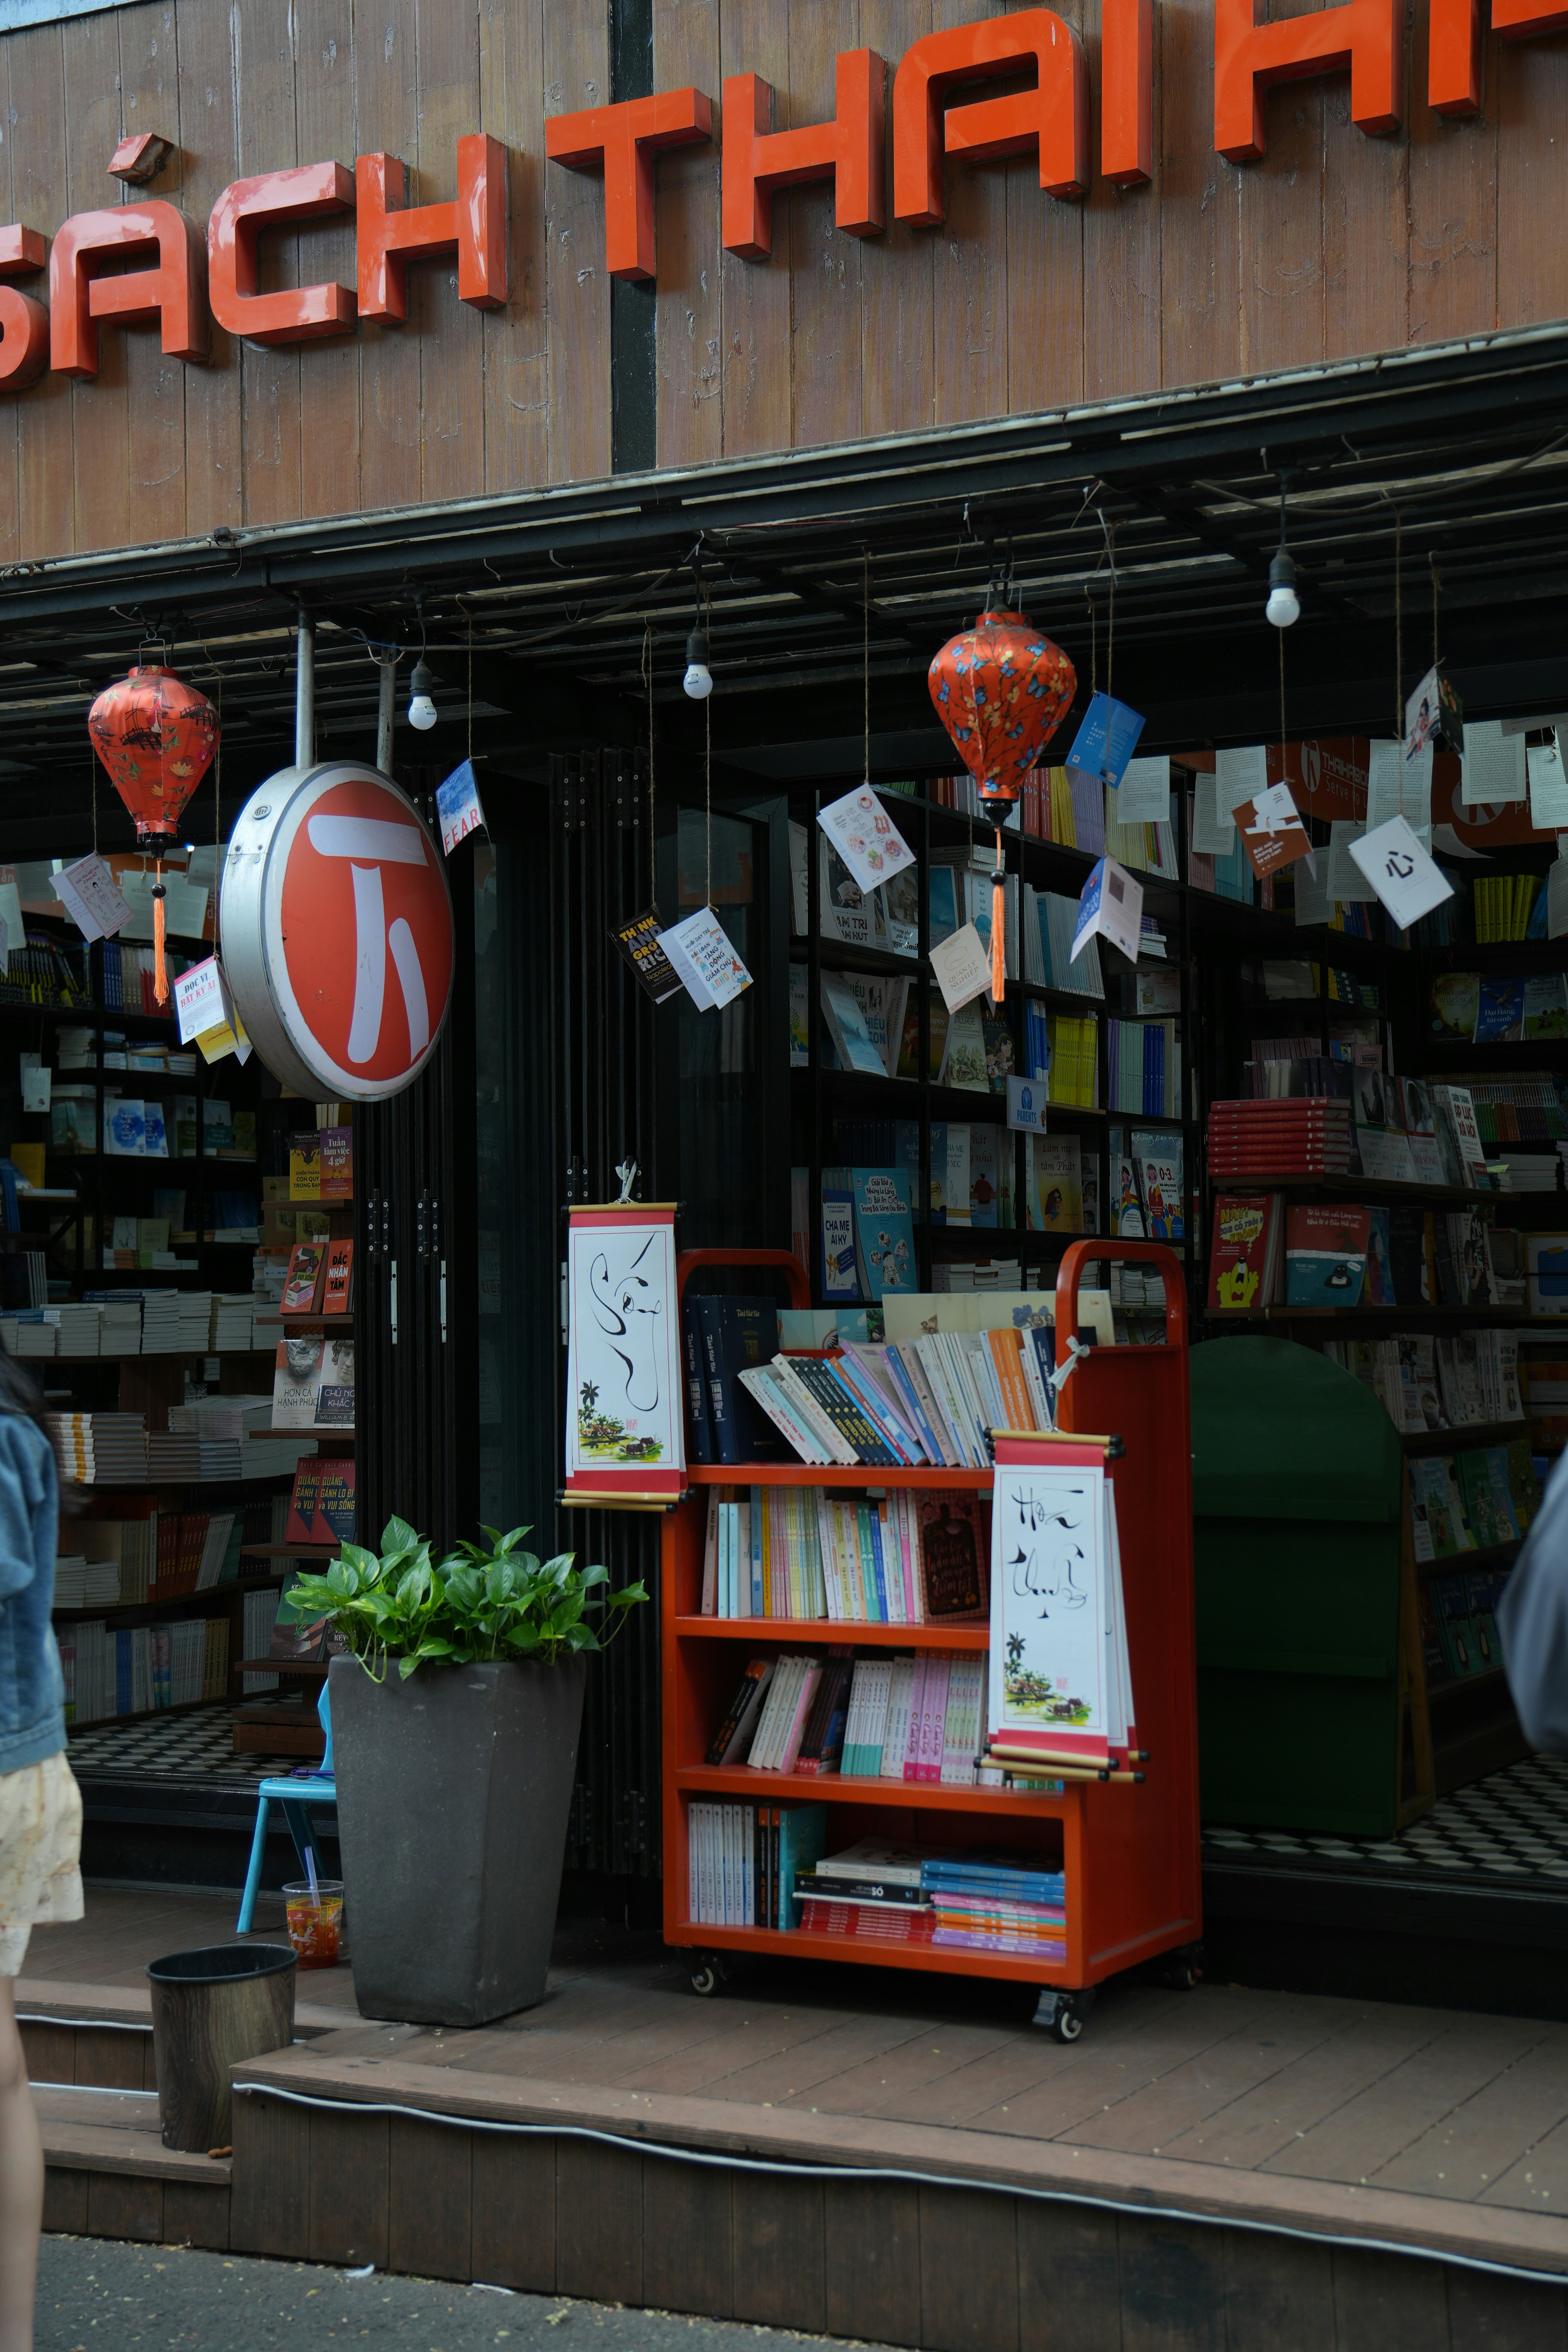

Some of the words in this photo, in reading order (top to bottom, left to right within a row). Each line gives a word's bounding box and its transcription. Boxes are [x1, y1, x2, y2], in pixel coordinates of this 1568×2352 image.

[1326, 776, 1348, 800] Serve
[444, 808, 481, 855] FEAR
[620, 916, 658, 943] THINK
[628, 925, 663, 953] AND
[852, 931, 868, 941] HÚT
[704, 945, 719, 961] TĂNG
[709, 952, 725, 968] ĐỘNG
[719, 959, 731, 973] CHÚ
[185, 978, 199, 994] ĐỌC
[200, 972, 209, 983] VỊ
[180, 993, 194, 1008] BẤT
[196, 984, 205, 998] KỲ
[208, 980, 216, 991] AI
[1498, 1007, 1516, 1017] Bàng
[954, 1015, 975, 1026] VILLAGE
[1017, 1109, 1037, 1124] PARENTS
[327, 1136, 346, 1147] Tuần
[323, 1147, 337, 1155] làm
[337, 1147, 350, 1156] việc
[1042, 1143, 1059, 1153] Làm
[1061, 1145, 1072, 1155] mẹ
[328, 1156, 334, 1166] 4
[335, 1155, 346, 1166] giờ
[976, 1150, 993, 1162] nhà
[1041, 1161, 1054, 1171] tâm
[1057, 1159, 1076, 1173] Phật
[866, 1187, 880, 1195] Những
[861, 1204, 872, 1213] Trong
[879, 1204, 889, 1212] Sống
[1220, 1203, 1249, 1224] NÀY!
[825, 1220, 838, 1231] CHA
[839, 1220, 849, 1233] MẸ
[831, 1231, 838, 1245] ÁI
[332, 1250, 347, 1265] ĐẮC
[305, 1273, 316, 1282] SỐNG
[328, 1265, 349, 1279] NHÂN
[330, 1279, 345, 1291] TÂM
[284, 1387, 300, 1397] HƠN
[302, 1386, 312, 1397] CẢ
[277, 1398, 299, 1408] HẠNH
[327, 1397, 351, 1407] KHẮC
[322, 1473, 343, 1486] QUẲNG
[296, 1487, 313, 1497] GÁNH
[320, 1487, 337, 1498] GÁNH
[337, 1488, 346, 1498] LO
[347, 1489, 354, 1498] ĐI
[294, 1501, 301, 1510] và
[303, 1500, 315, 1510] VUI
[318, 1502, 326, 1510] và
[327, 1501, 337, 1510] VUI
[338, 1498, 356, 1510] SỐNG
